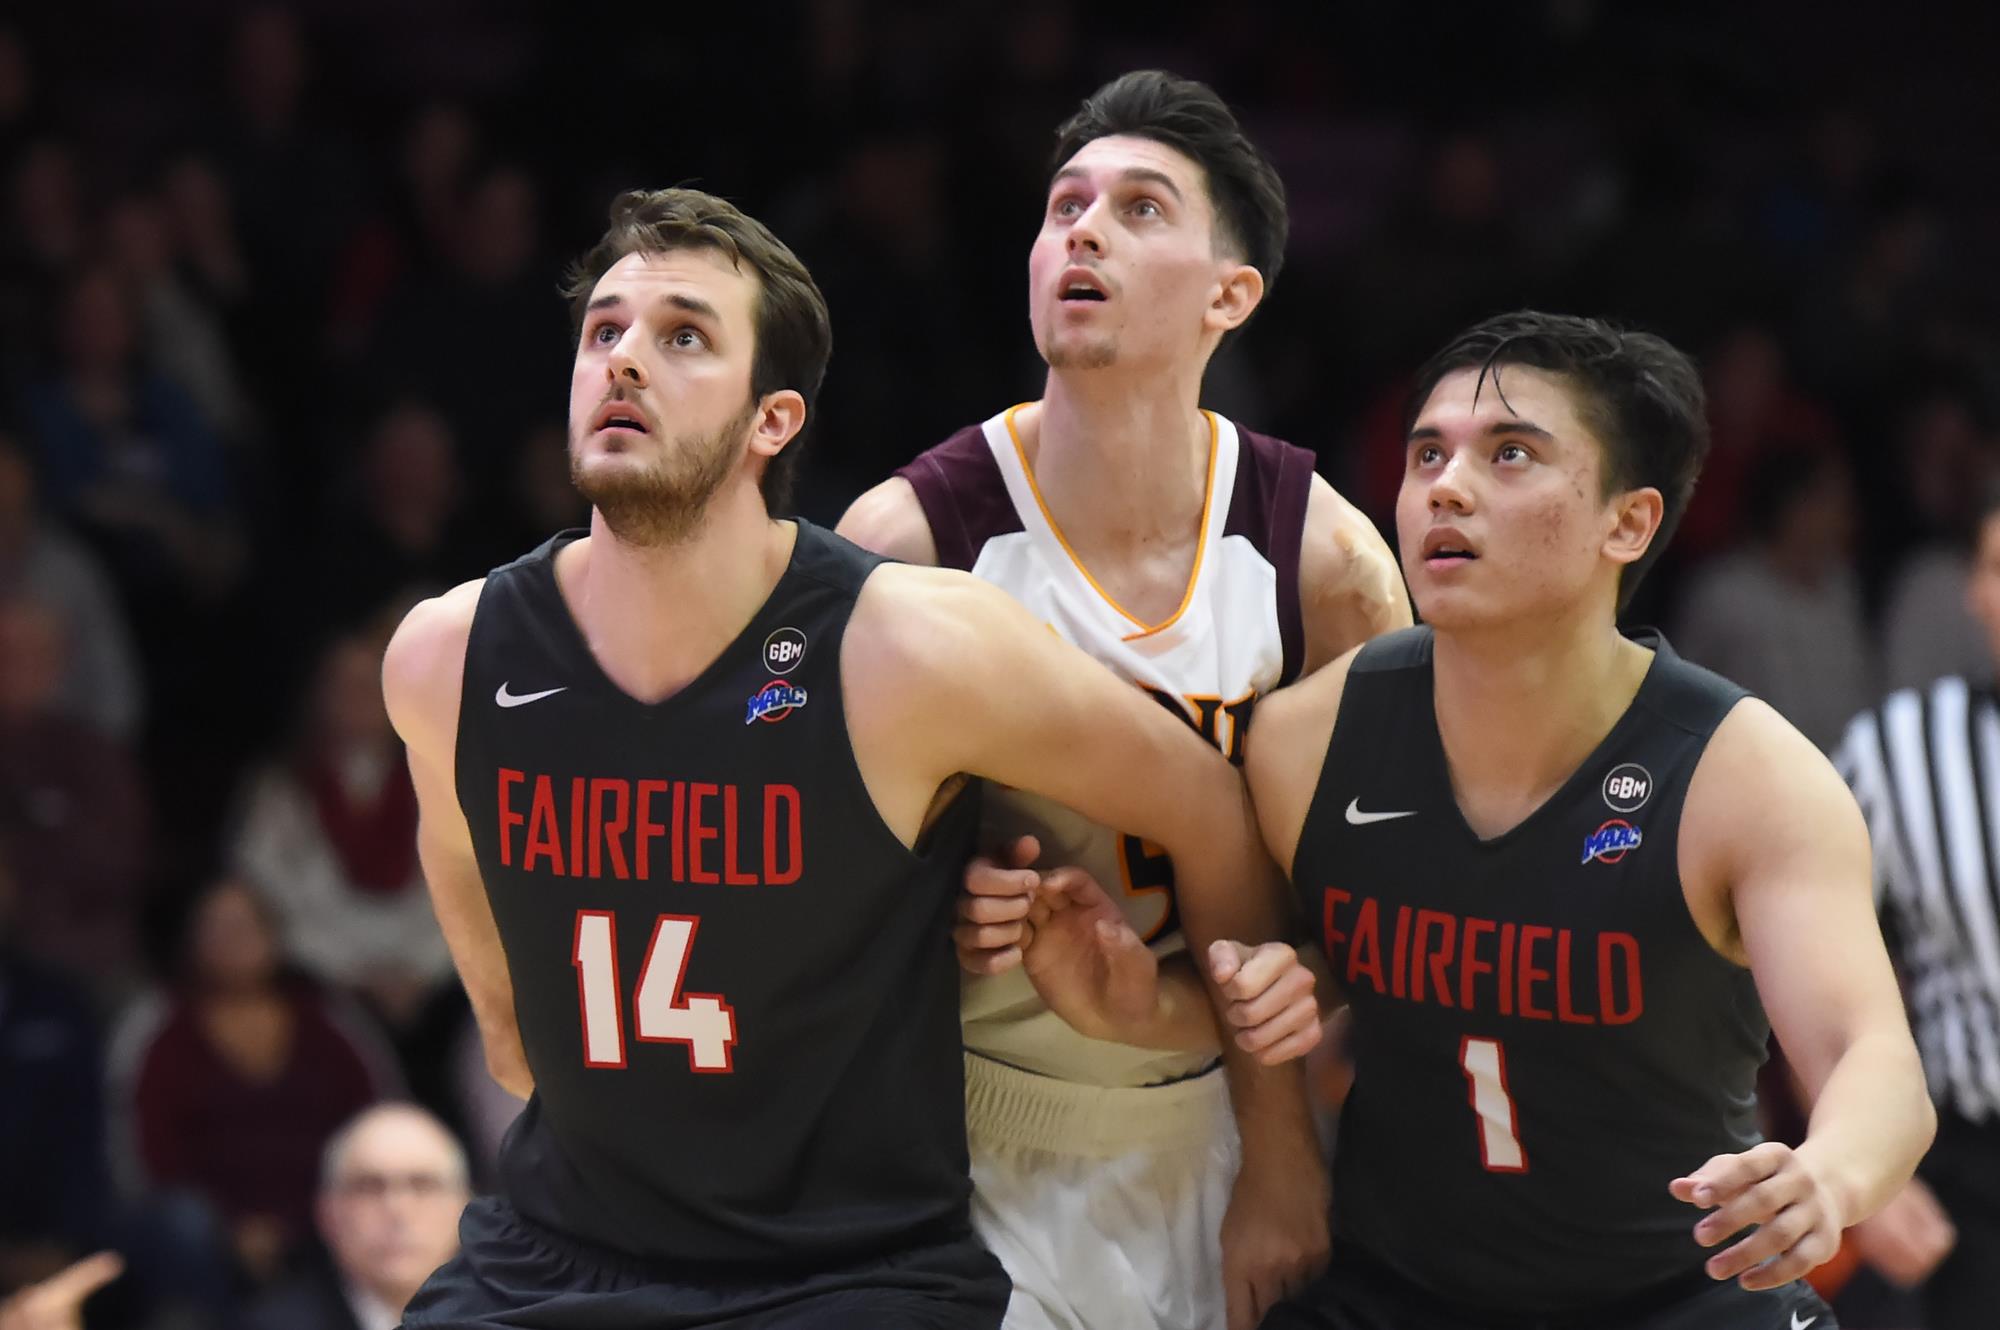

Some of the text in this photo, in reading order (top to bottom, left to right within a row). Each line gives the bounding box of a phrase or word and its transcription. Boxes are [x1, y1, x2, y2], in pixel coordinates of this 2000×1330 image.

[769, 641, 802, 662] GBM
[746, 686, 807, 725] MAAC
[498, 767, 803, 885] FAIRFIELD
[1609, 776, 1647, 799] GBM
[1581, 825, 1642, 865] MAAC
[571, 909, 738, 1074] 14
[1323, 886, 1643, 1025] FAIRFIELD
[1458, 1034, 1529, 1174] 1
